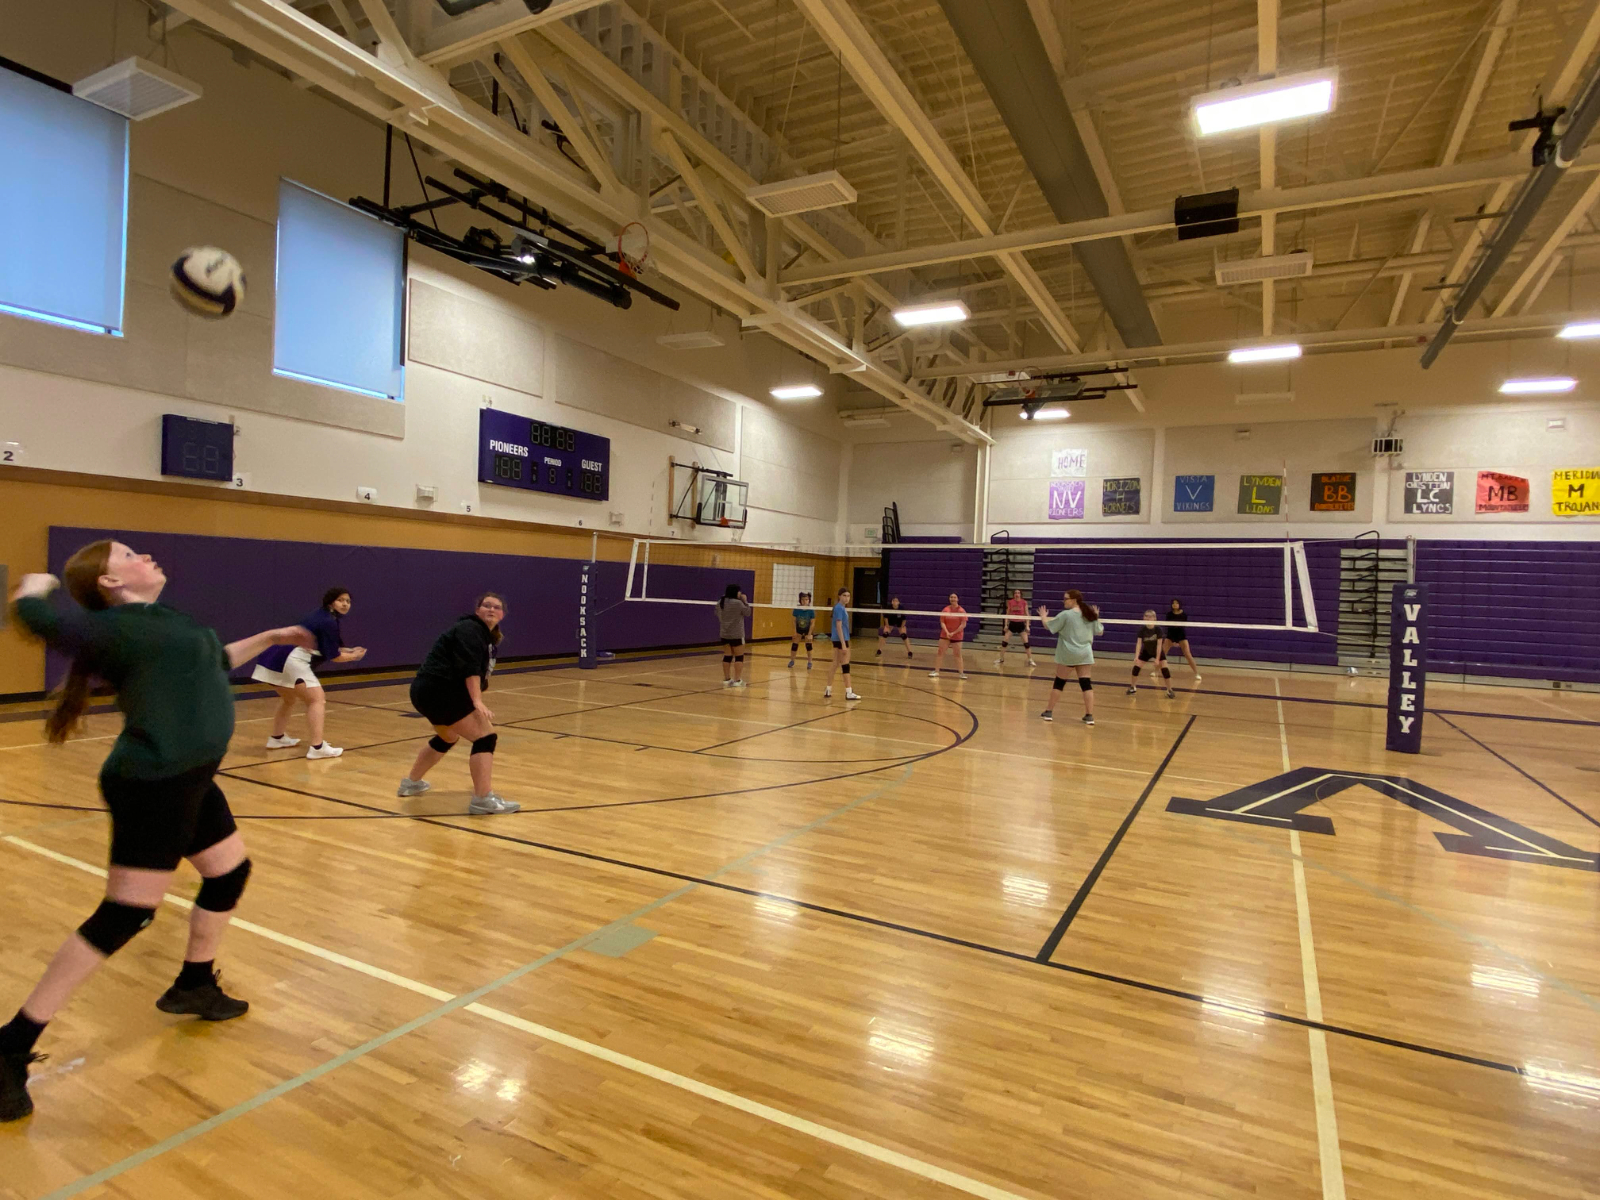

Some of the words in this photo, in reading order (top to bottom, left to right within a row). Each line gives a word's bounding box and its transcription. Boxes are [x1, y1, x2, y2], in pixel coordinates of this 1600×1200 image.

[490, 439, 528, 457] PIONEERS
[3, 450, 14, 461] 2
[544, 456, 562, 467] PERIOD
[1057, 454, 1085, 469] HOME
[581, 459, 602, 472] GUEST
[236, 478, 243, 487] 3
[1180, 475, 1207, 483] VISTA
[1413, 472, 1447, 482] LYNDEN
[1103, 480, 1140, 491] HORIZON
[1568, 483, 1585, 498] M
[364, 492, 371, 501] 4
[1116, 492, 1125, 502] H
[1185, 485, 1203, 500] V
[1251, 486, 1266, 503] L
[1323, 485, 1352, 502] BB
[1416, 489, 1440, 503] LC
[1488, 485, 1518, 501] MB
[1052, 490, 1082, 509] NV
[466, 505, 471, 513] 5
[1176, 502, 1210, 511] VIKINGS
[1246, 504, 1275, 514] LIONS
[1412, 503, 1452, 513] LYNCS
[579, 574, 588, 658] NOOKSACK
[1398, 603, 1422, 734] VALLEY
